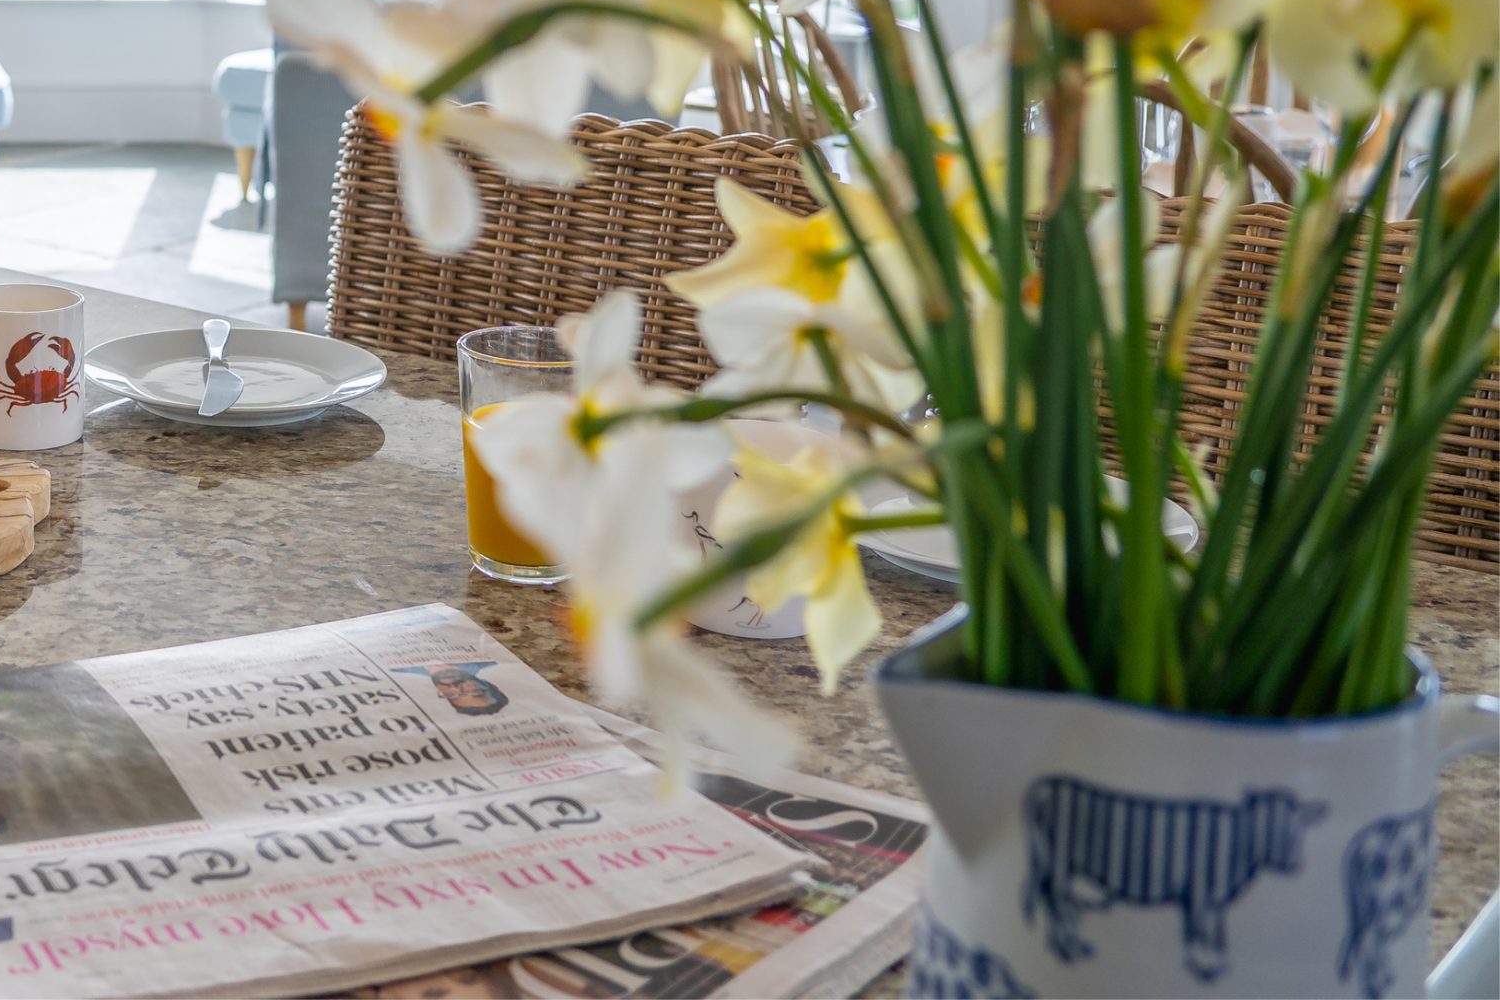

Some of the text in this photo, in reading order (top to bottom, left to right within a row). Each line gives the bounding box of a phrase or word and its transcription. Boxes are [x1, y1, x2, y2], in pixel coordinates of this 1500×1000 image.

[129, 665, 381, 711] NHS chiefs
[185, 689, 400, 730] safety, say
[204, 715, 429, 761] to patient
[241, 738, 453, 792] pose risk
[516, 759, 605, 785] INSIDE
[263, 774, 484, 817] Mail cuts
[459, 795, 602, 835] The
[246, 815, 459, 868] Daily
[371, 875, 491, 911] sixty
[500, 858, 595, 891] I'm
[212, 899, 329, 941] love
[333, 896, 365, 928] I
